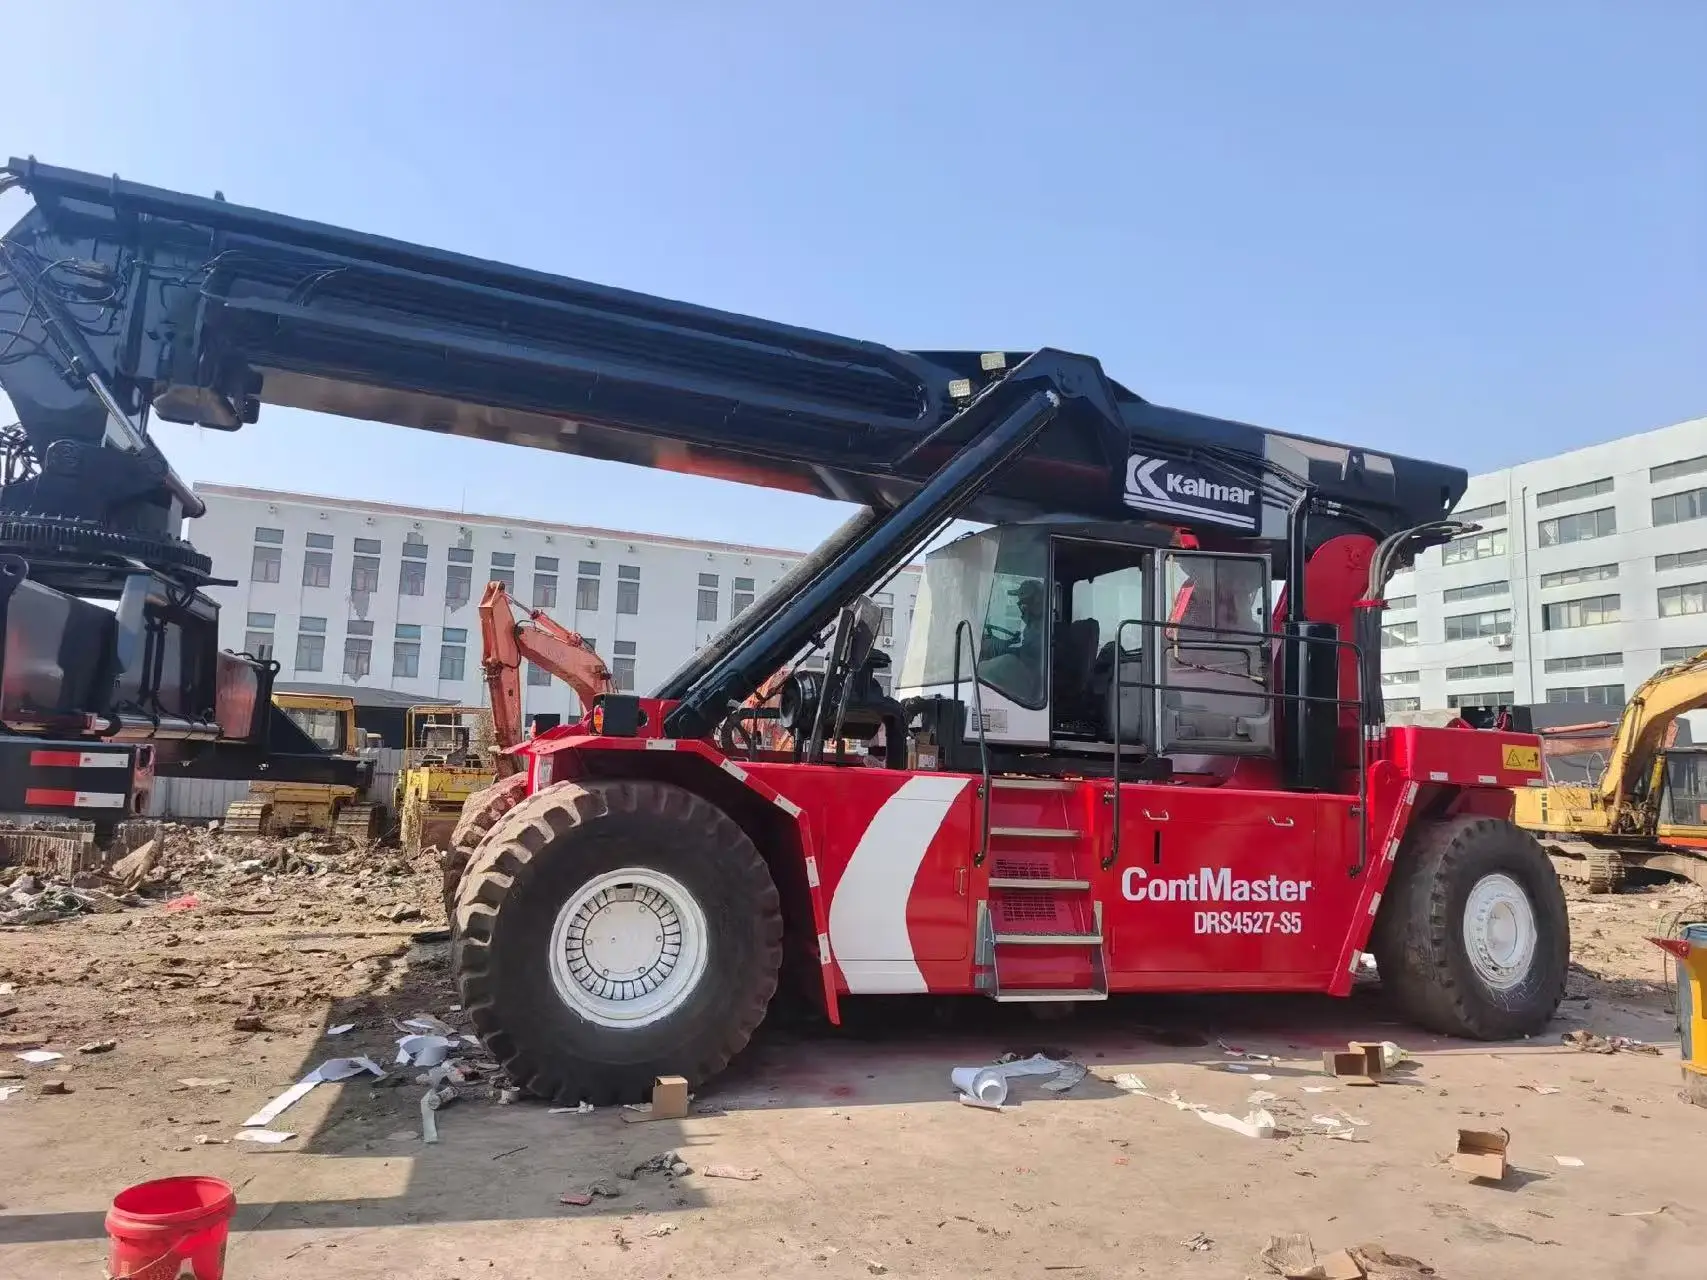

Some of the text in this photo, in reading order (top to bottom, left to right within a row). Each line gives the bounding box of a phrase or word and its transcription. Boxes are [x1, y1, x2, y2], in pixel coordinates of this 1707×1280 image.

[1166, 473, 1255, 505] Kalmar
[1121, 866, 1312, 901] ContMaster
[1194, 912, 1302, 934] DRS4527-S5
